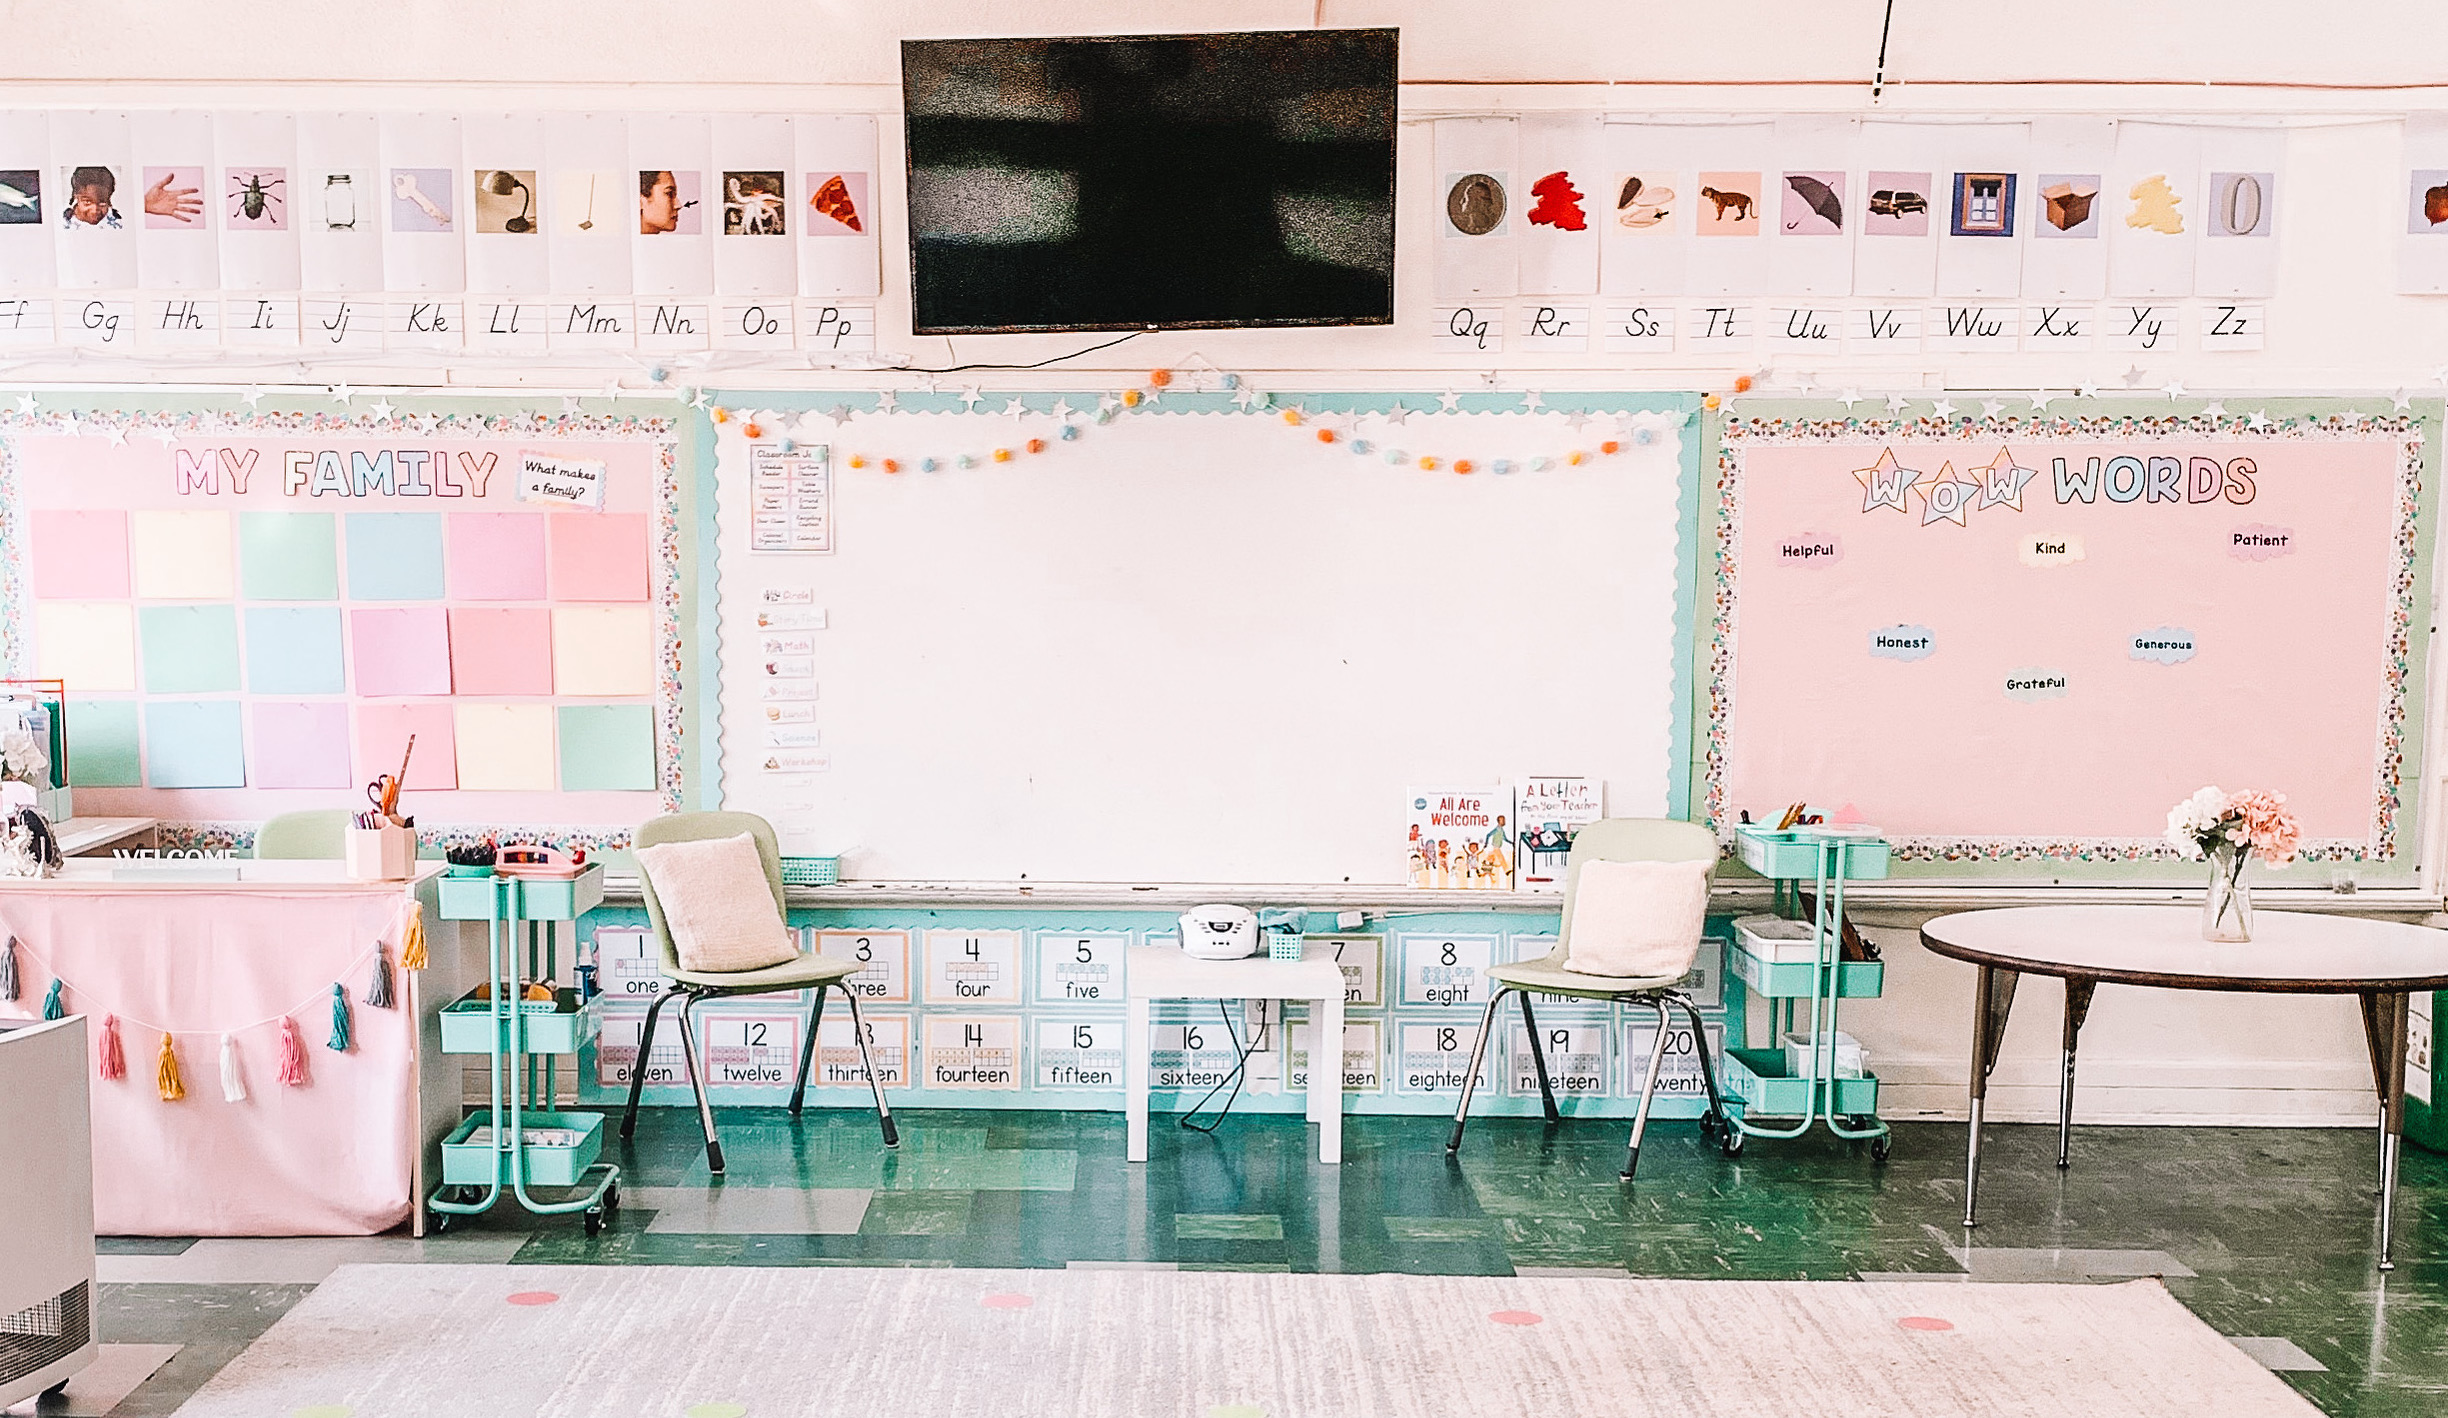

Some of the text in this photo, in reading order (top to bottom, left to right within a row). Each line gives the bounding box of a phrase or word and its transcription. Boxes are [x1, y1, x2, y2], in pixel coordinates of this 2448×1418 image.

[82, 301, 120, 343] Gg
[162, 300, 204, 330] Hh
[250, 300, 274, 329] Ii
[322, 301, 351, 344] Jj
[407, 303, 449, 332] Kk
[489, 304, 520, 334] Ll
[566, 304, 622, 334] Mm
[652, 305, 695, 335] Nn
[742, 306, 779, 336] Oo
[1530, 306, 1571, 337] Rr
[1625, 307, 1660, 337] Ss
[1705, 307, 1735, 338] Tt
[1786, 309, 1828, 340] Uu
[1869, 309, 1902, 339] Vv
[1947, 307, 2003, 337] Ww
[2033, 307, 2079, 337] Xx
[2210, 306, 2247, 336] Zz
[815, 307, 852, 349] Pp
[1449, 307, 1489, 350] Qq
[2127, 306, 2163, 349] Yy
[175, 447, 498, 498] MY FAMILY
[525, 460, 596, 481] What makes
[531, 482, 585, 500] a family?
[1870, 456, 2258, 513] WOW WORDS
[1782, 543, 1834, 560] Helpful
[2035, 541, 2066, 555] Kind
[2233, 533, 2289, 547] Patient
[1876, 635, 1929, 650] Honest
[2135, 637, 2193, 650] Generous
[2006, 676, 2065, 692] Grateful
[1526, 781, 1588, 798] A Letter
[1439, 796, 1481, 811] All Are
[1431, 812, 1489, 827] Welcome
[102, 848, 240, 869] WELCOME
[855, 937, 873, 962] 3
[965, 938, 981, 962] 4
[1075, 939, 1092, 964] 5
[1330, 941, 1346, 963] 7
[1440, 942, 1458, 967] 8
[626, 980, 660, 994] one
[842, 979, 887, 997] ree
[955, 979, 991, 998] four
[1066, 980, 1100, 999] five
[1426, 984, 1470, 1004] eight
[743, 1022, 768, 1047] 12
[964, 1023, 984, 1048] 14
[1073, 1024, 1093, 1049] 15
[1183, 1025, 1204, 1050] 16
[1437, 1027, 1458, 1052] 18
[1549, 1029, 1570, 1054] 19
[1662, 1030, 1693, 1056] 20
[723, 1063, 782, 1082] twelve
[935, 1064, 1010, 1083] fourteen
[1051, 1066, 1112, 1084] fifteen
[1160, 1068, 1224, 1085] sixteen
[1292, 1071, 1376, 1085] seteen
[1521, 1071, 1599, 1089] nieteen
[1653, 1073, 1708, 1096] wenty
